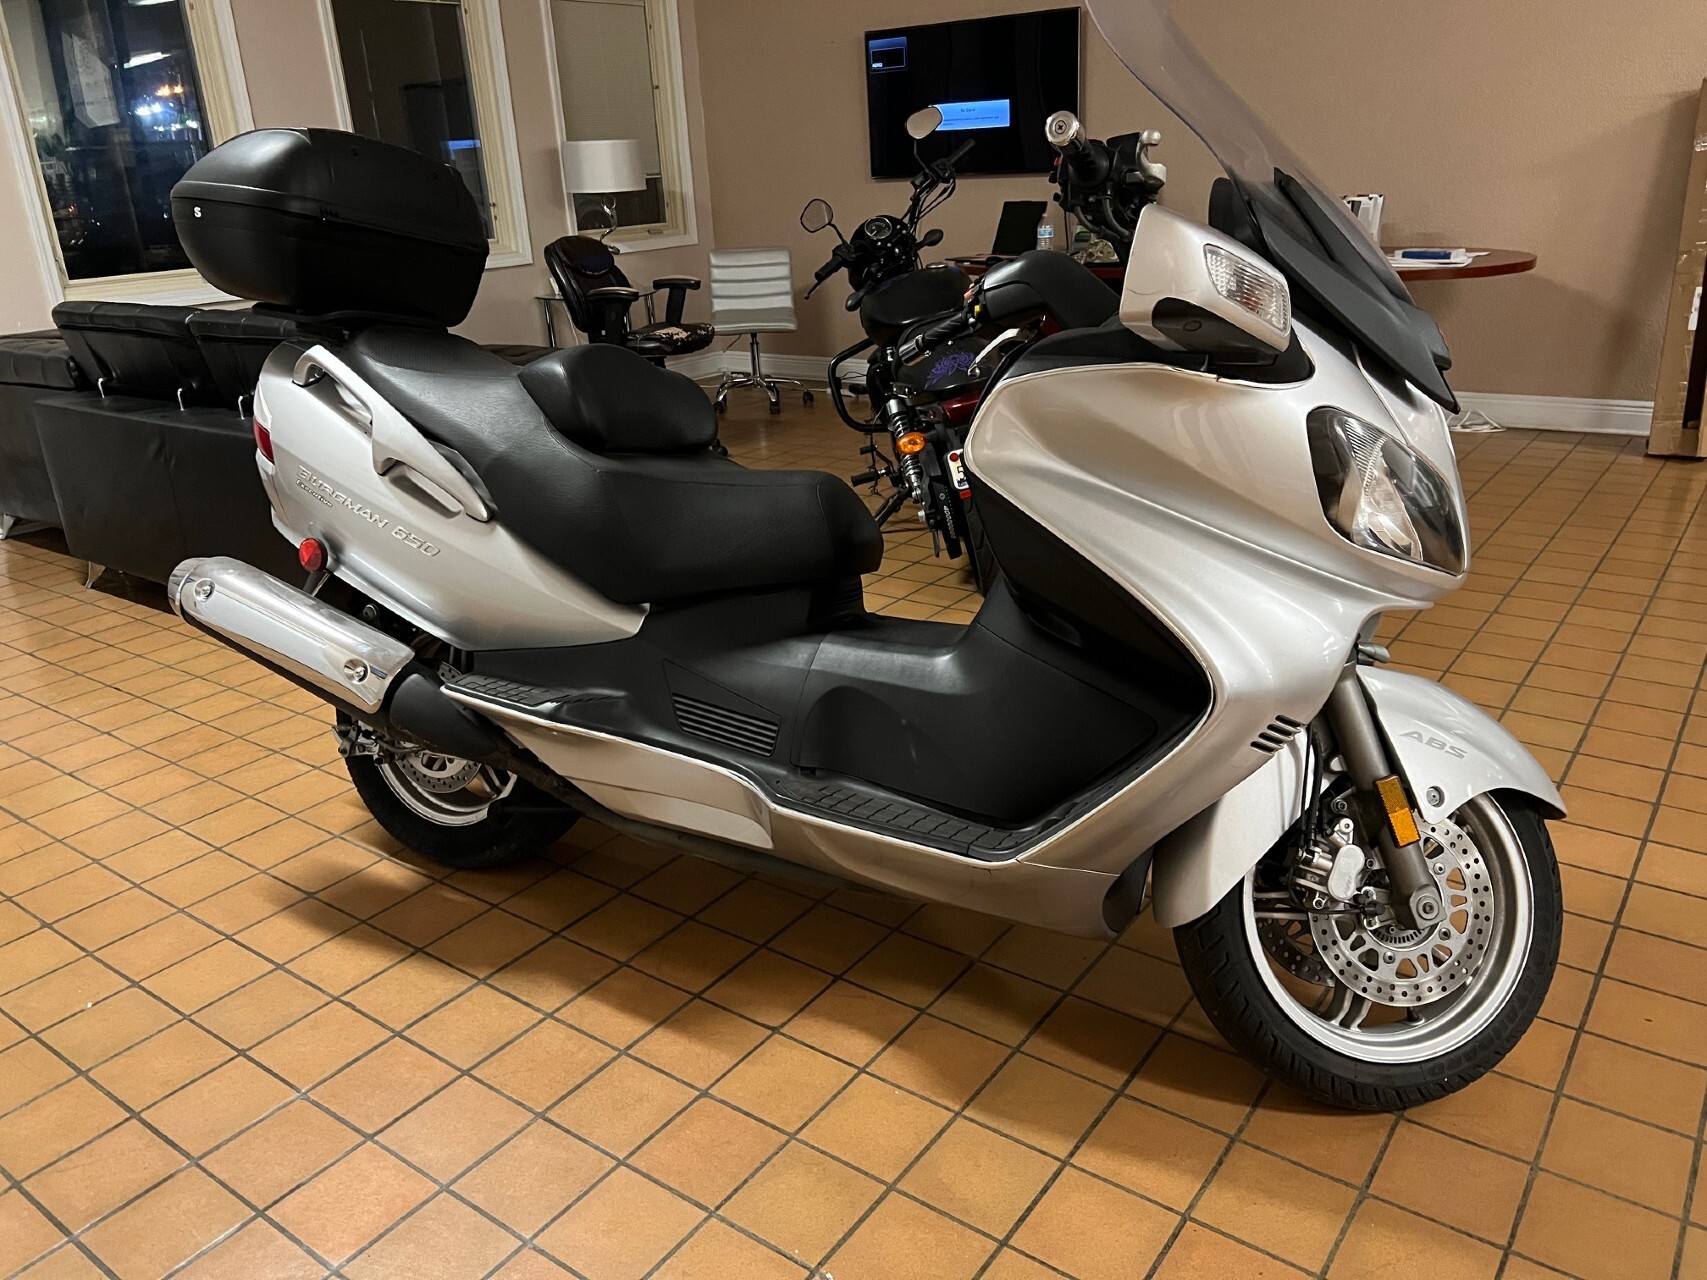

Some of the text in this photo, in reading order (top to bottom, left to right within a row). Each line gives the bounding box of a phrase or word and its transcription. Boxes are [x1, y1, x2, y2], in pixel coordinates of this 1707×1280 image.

[296, 479, 333, 508] Executive
[297, 465, 441, 557] BURGMAN 650
[1399, 730, 1468, 759] ABS
